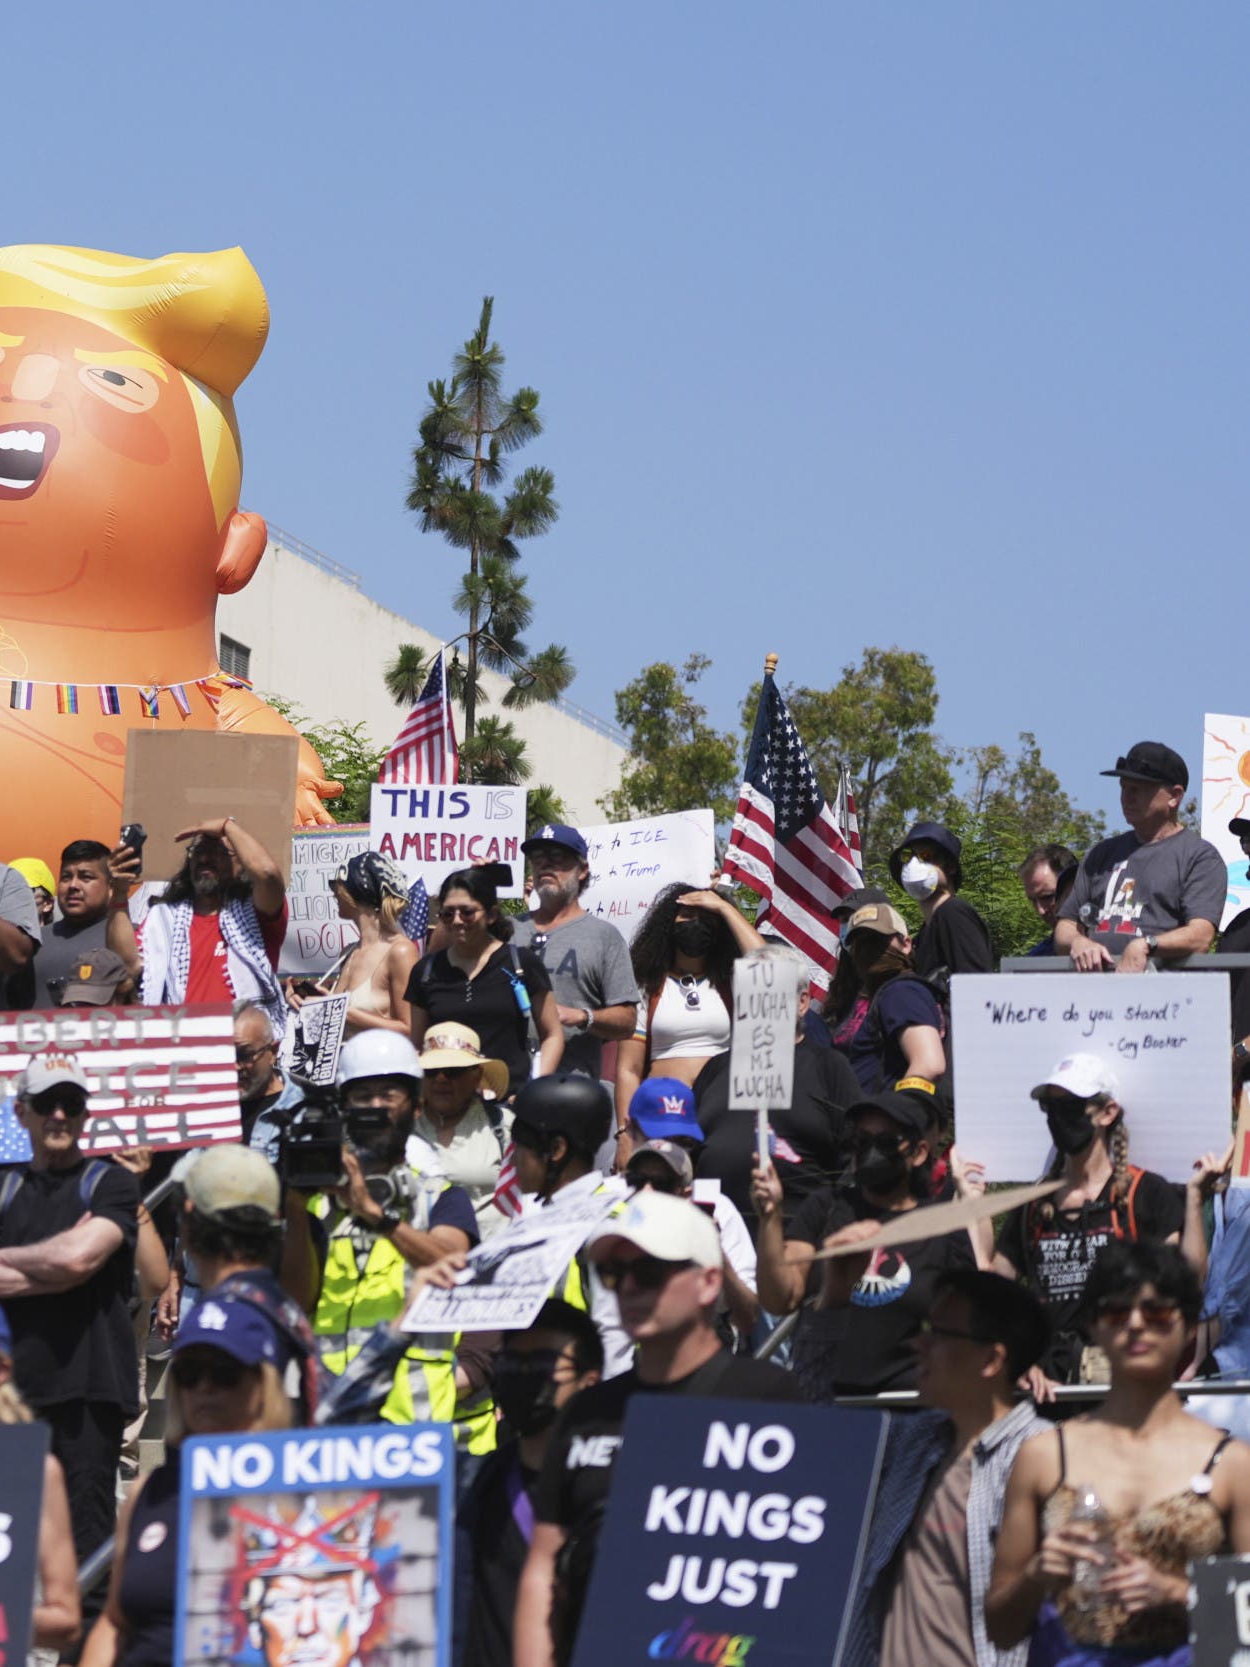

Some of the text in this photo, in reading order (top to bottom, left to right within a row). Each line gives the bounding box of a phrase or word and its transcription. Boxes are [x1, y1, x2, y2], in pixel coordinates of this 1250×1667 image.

[381, 789, 515, 819] THIS IS
[379, 832, 518, 862] AMERICAN
[630, 830, 669, 846] ICE
[622, 862, 661, 878] Trump
[608, 900, 633, 919] ALL
[748, 962, 774, 987] TU
[735, 992, 789, 1021] LUCHA
[1062, 1003, 1079, 1021] do
[1082, 1007, 1113, 1037] you
[319, 998, 345, 1080] BILLIONAIRES
[752, 1024, 775, 1050] ES
[750, 1051, 775, 1071] MI
[733, 1074, 786, 1099] LUCHA
[89, 1111, 213, 1148] ALL
[192, 1431, 444, 1490] NO KINGS
[703, 1421, 796, 1473] NO
[645, 1485, 827, 1544] KINGS
[647, 1554, 798, 1610] JUST
